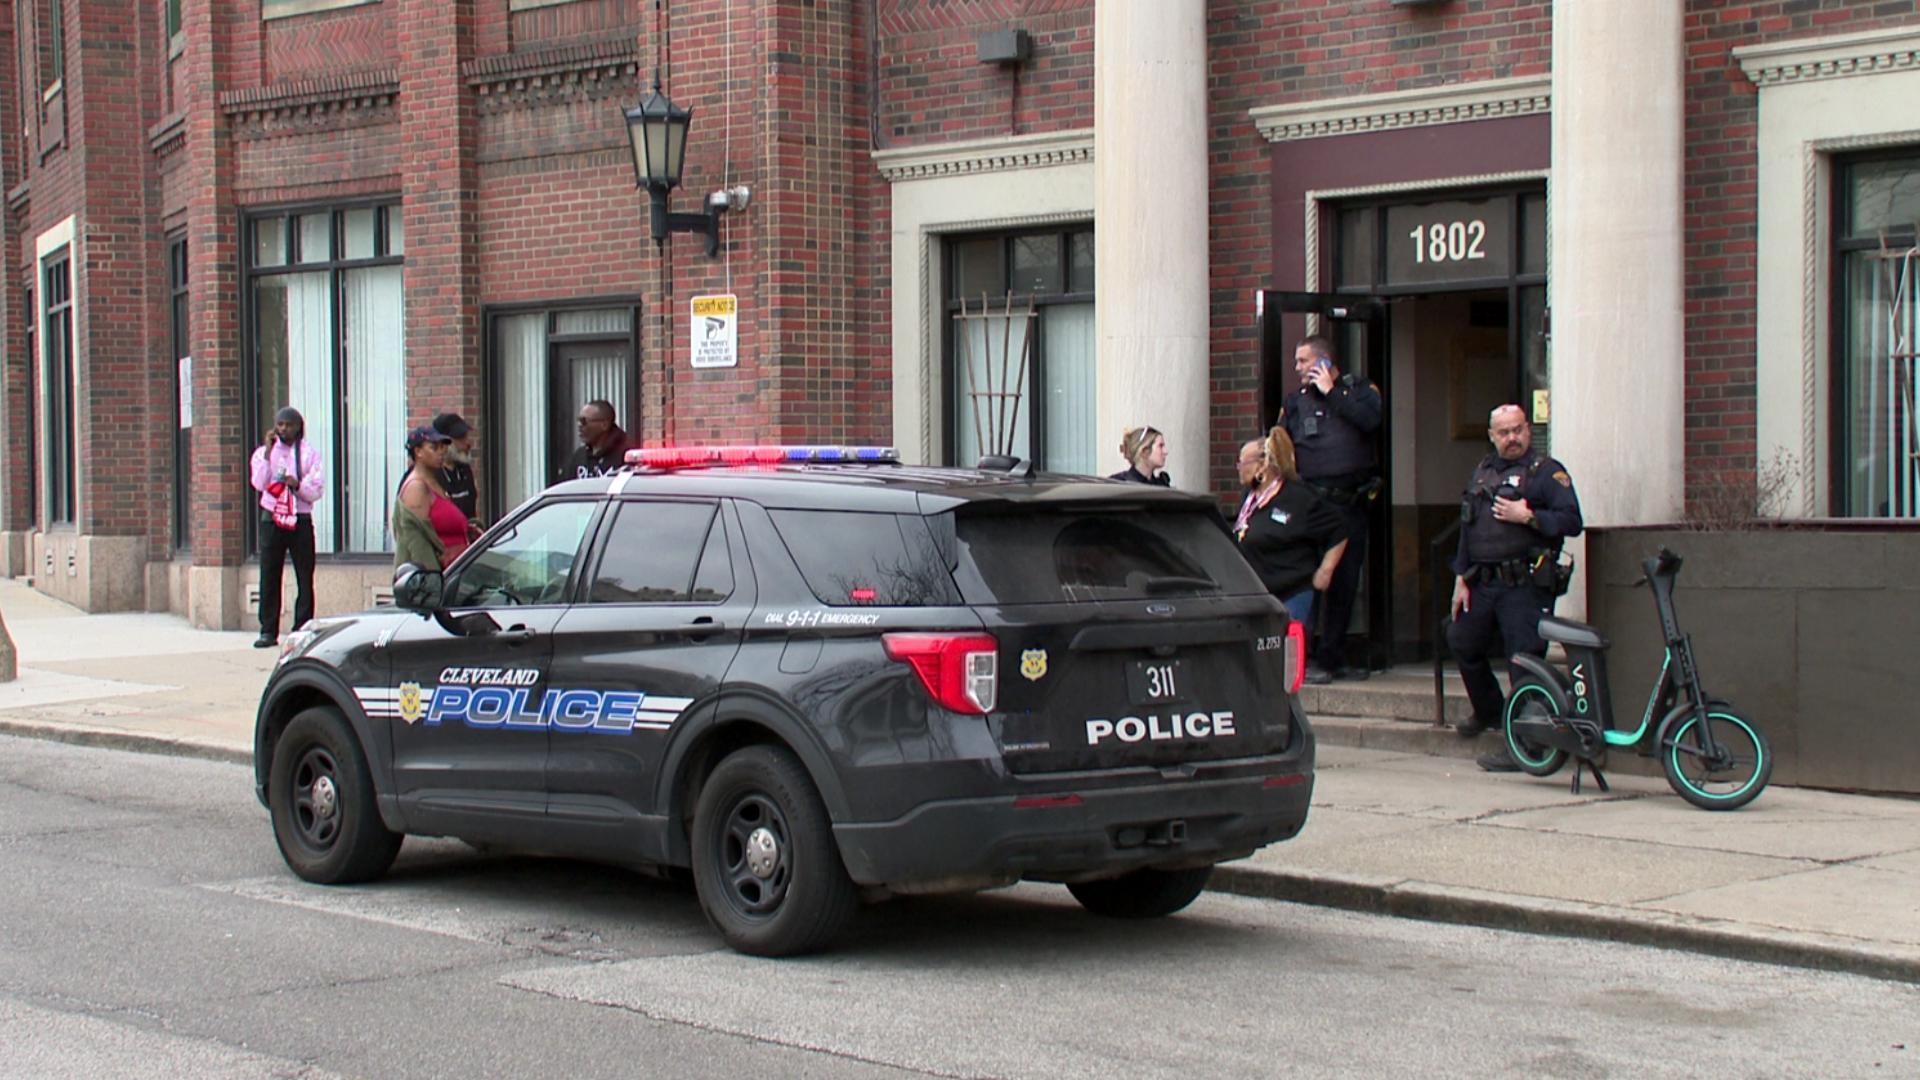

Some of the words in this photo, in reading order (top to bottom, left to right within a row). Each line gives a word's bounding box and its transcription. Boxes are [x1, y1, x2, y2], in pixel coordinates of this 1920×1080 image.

[1409, 219, 1486, 264] 1802
[786, 610, 821, 626] 9-1-1
[821, 613, 880, 624] EMERGENCY
[439, 666, 539, 686] CLEVELAND
[1146, 665, 1176, 698] 311
[1572, 663, 1588, 714] veo
[424, 685, 646, 736] POLICE
[1085, 711, 1236, 745] POLICE
